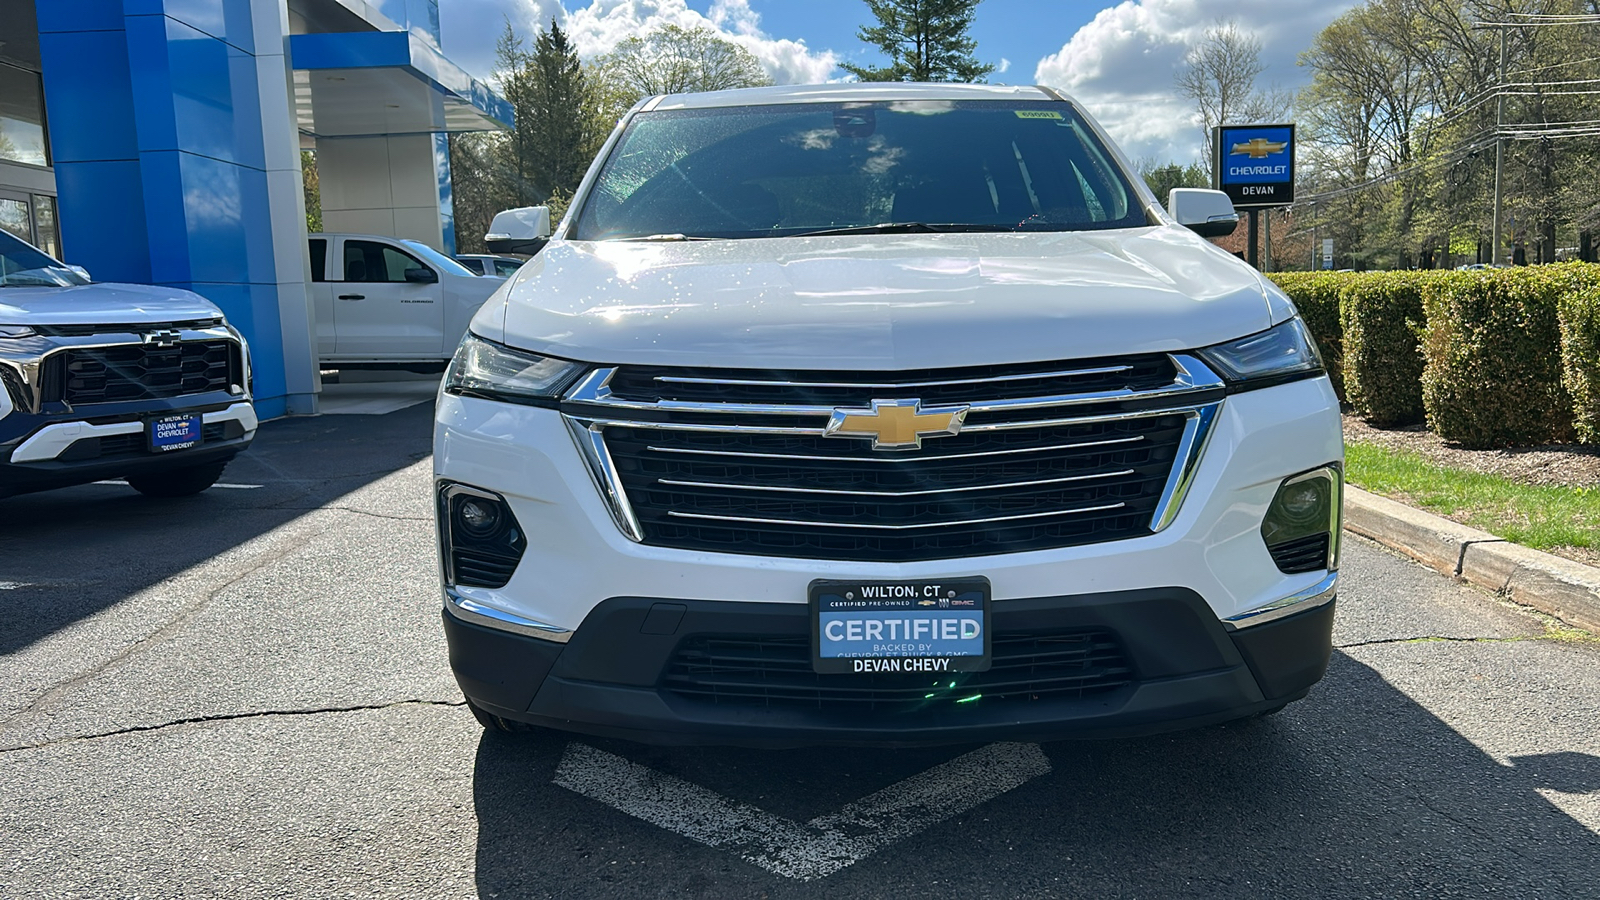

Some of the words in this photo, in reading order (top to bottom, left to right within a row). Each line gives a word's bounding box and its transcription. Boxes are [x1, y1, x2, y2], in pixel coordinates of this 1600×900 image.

[1230, 165, 1287, 176] CHEVROLET
[1242, 186, 1274, 195] DEVAN
[157, 422, 177, 431] DEVAN
[157, 428, 189, 438] CHEVROLET
[861, 586, 919, 598] WILTON,
[923, 585, 941, 597] CT
[825, 618, 981, 641] CERTIFIED
[873, 643, 915, 652] BACKED
[918, 643, 932, 651] BY
[854, 659, 900, 672] DEVAN
[903, 658, 950, 671] CHEVY
